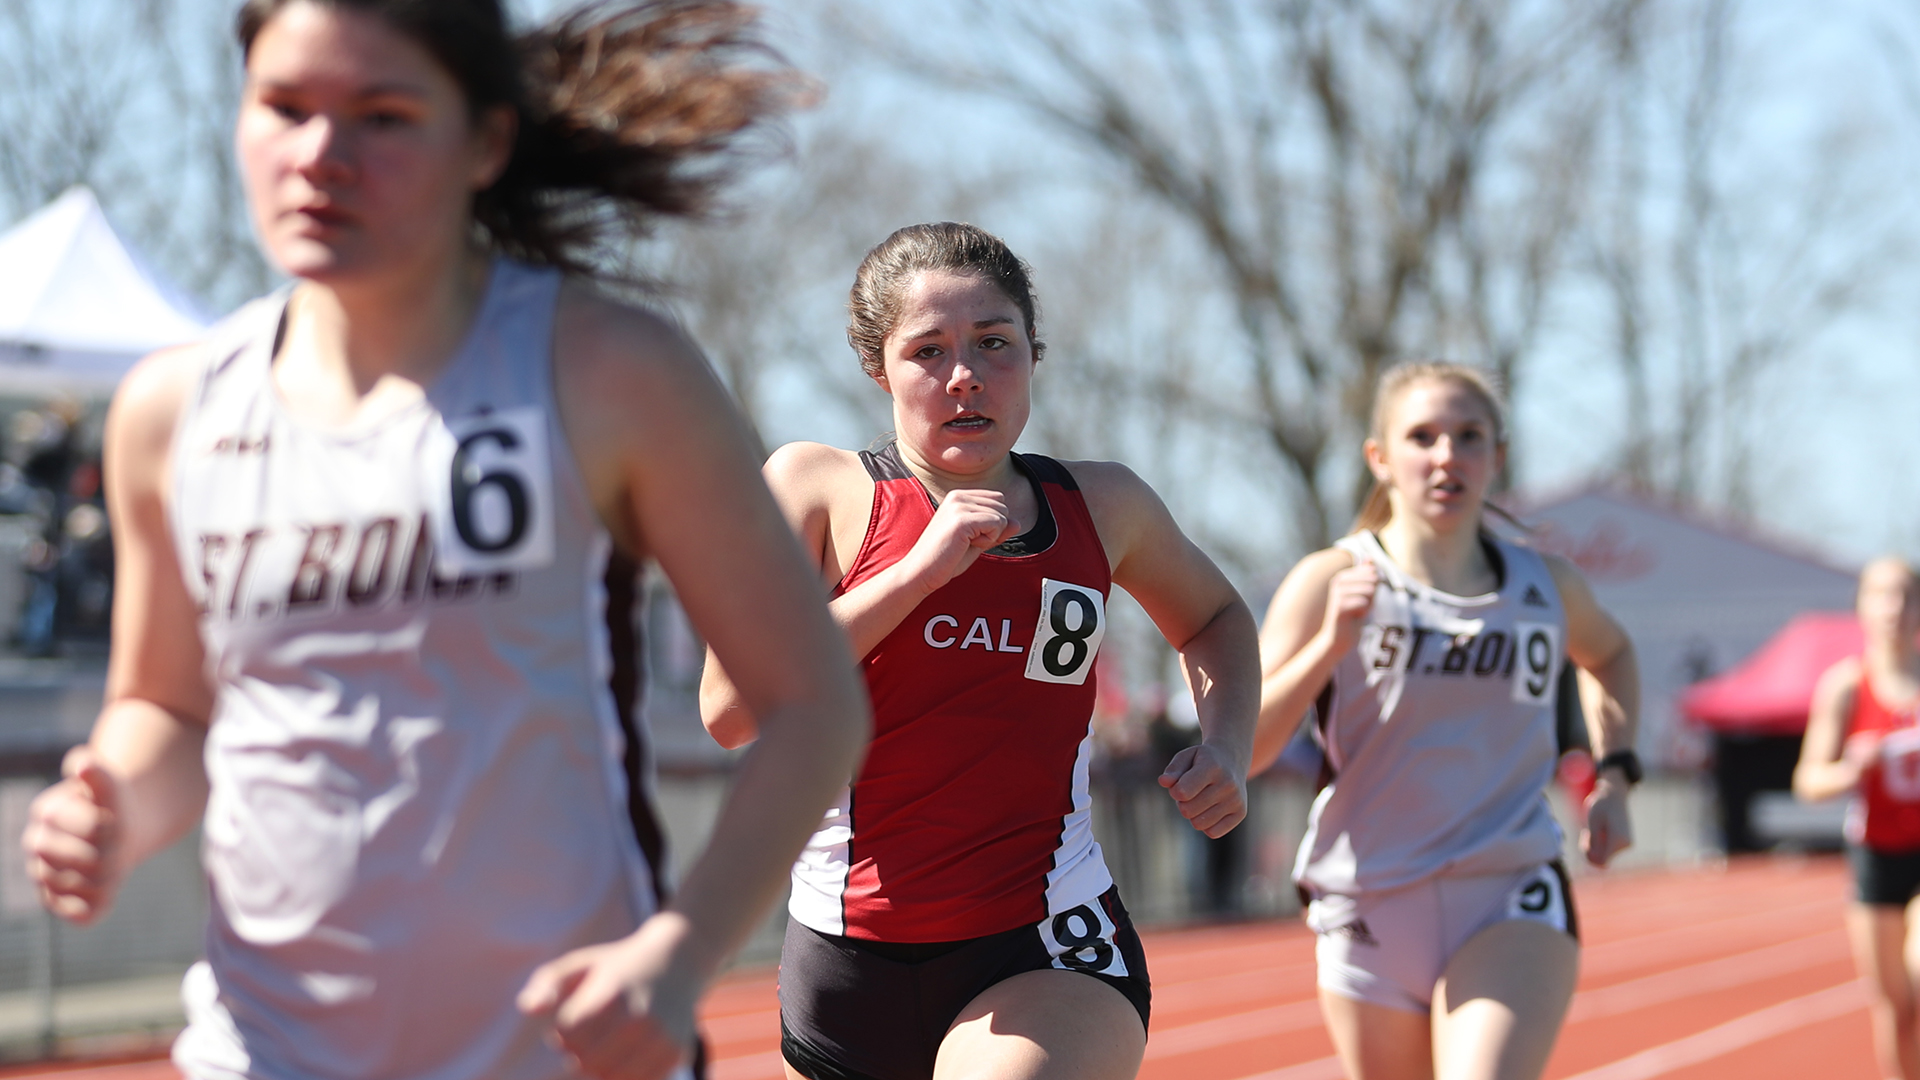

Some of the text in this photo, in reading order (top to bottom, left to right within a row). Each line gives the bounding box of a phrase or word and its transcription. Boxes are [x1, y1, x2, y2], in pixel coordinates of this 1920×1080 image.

[450, 428, 530, 553] 6
[922, 614, 1024, 653] CAL
[1042, 588, 1098, 677] 8
[1526, 630, 1550, 697] 9
[1051, 903, 1114, 972] 8
